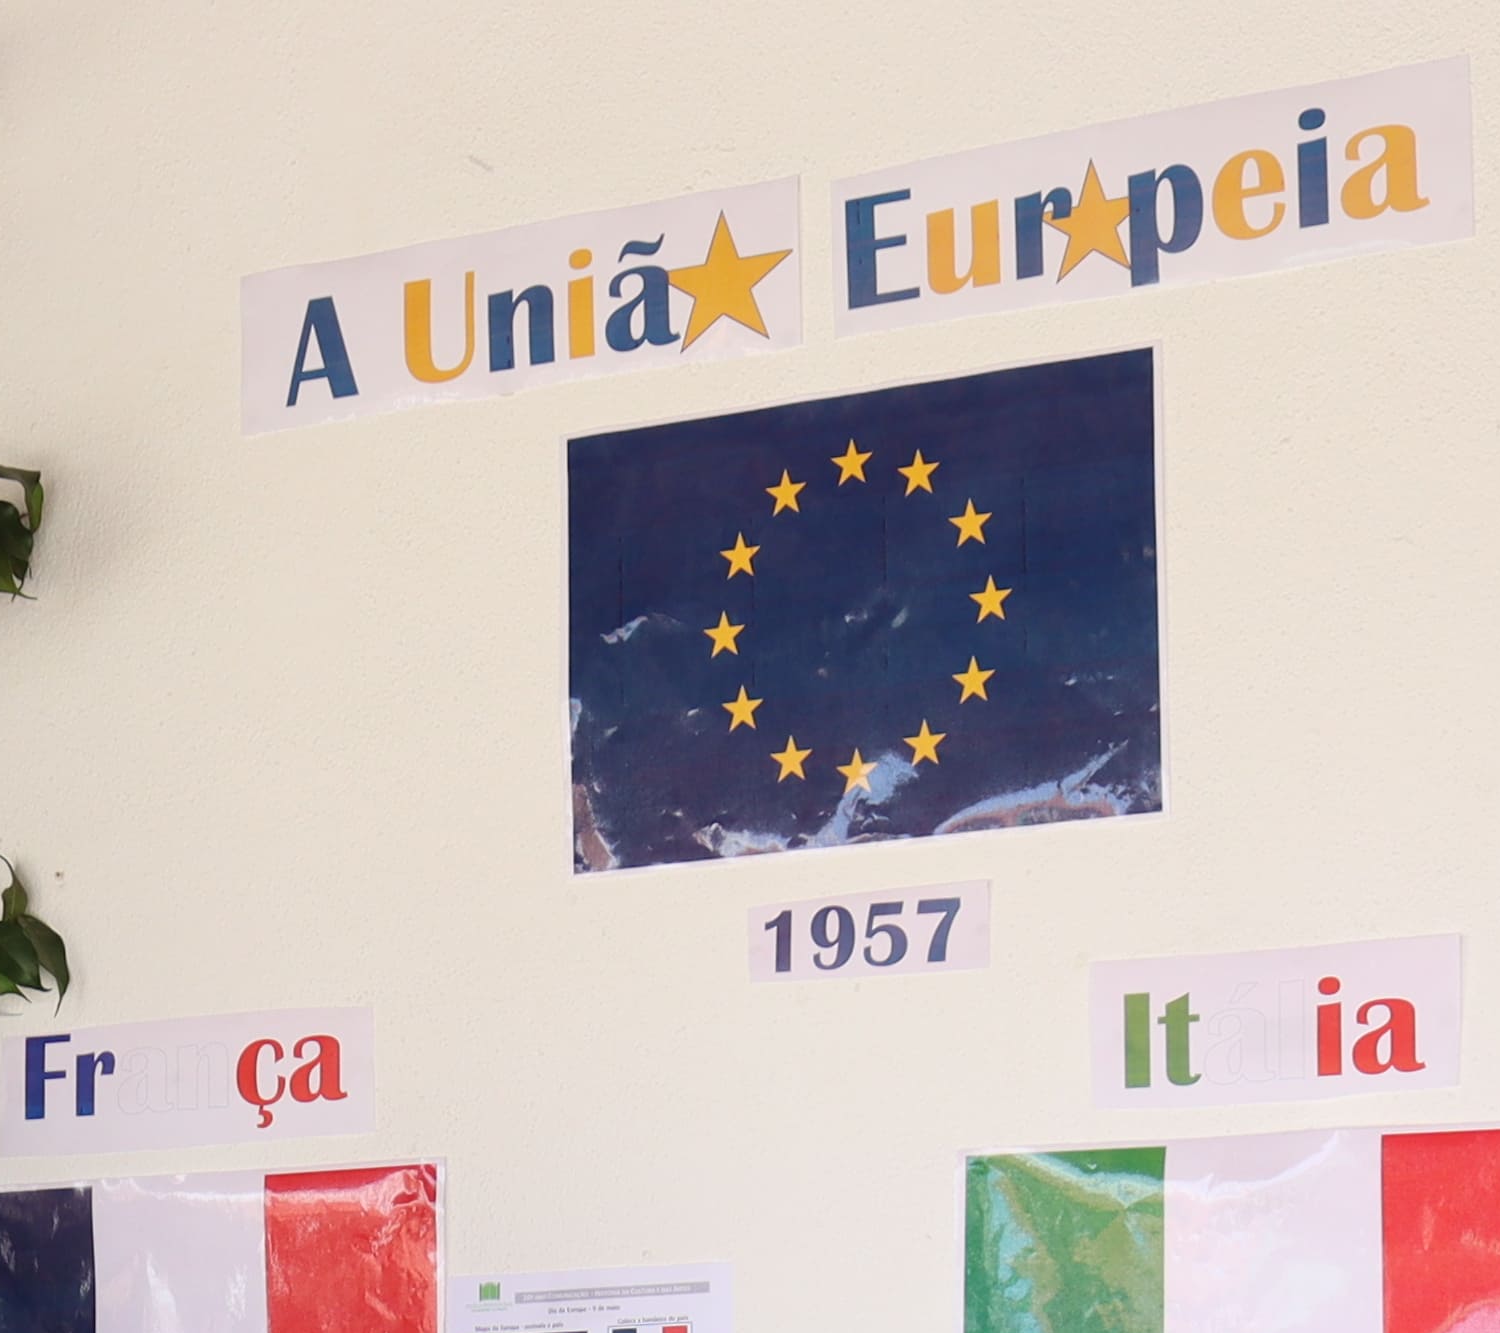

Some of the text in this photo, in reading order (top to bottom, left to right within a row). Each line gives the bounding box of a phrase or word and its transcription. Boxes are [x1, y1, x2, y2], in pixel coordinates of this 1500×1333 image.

[286, 107, 1431, 407] A Uniã Eurpeia
[763, 895, 963, 974] 1957
